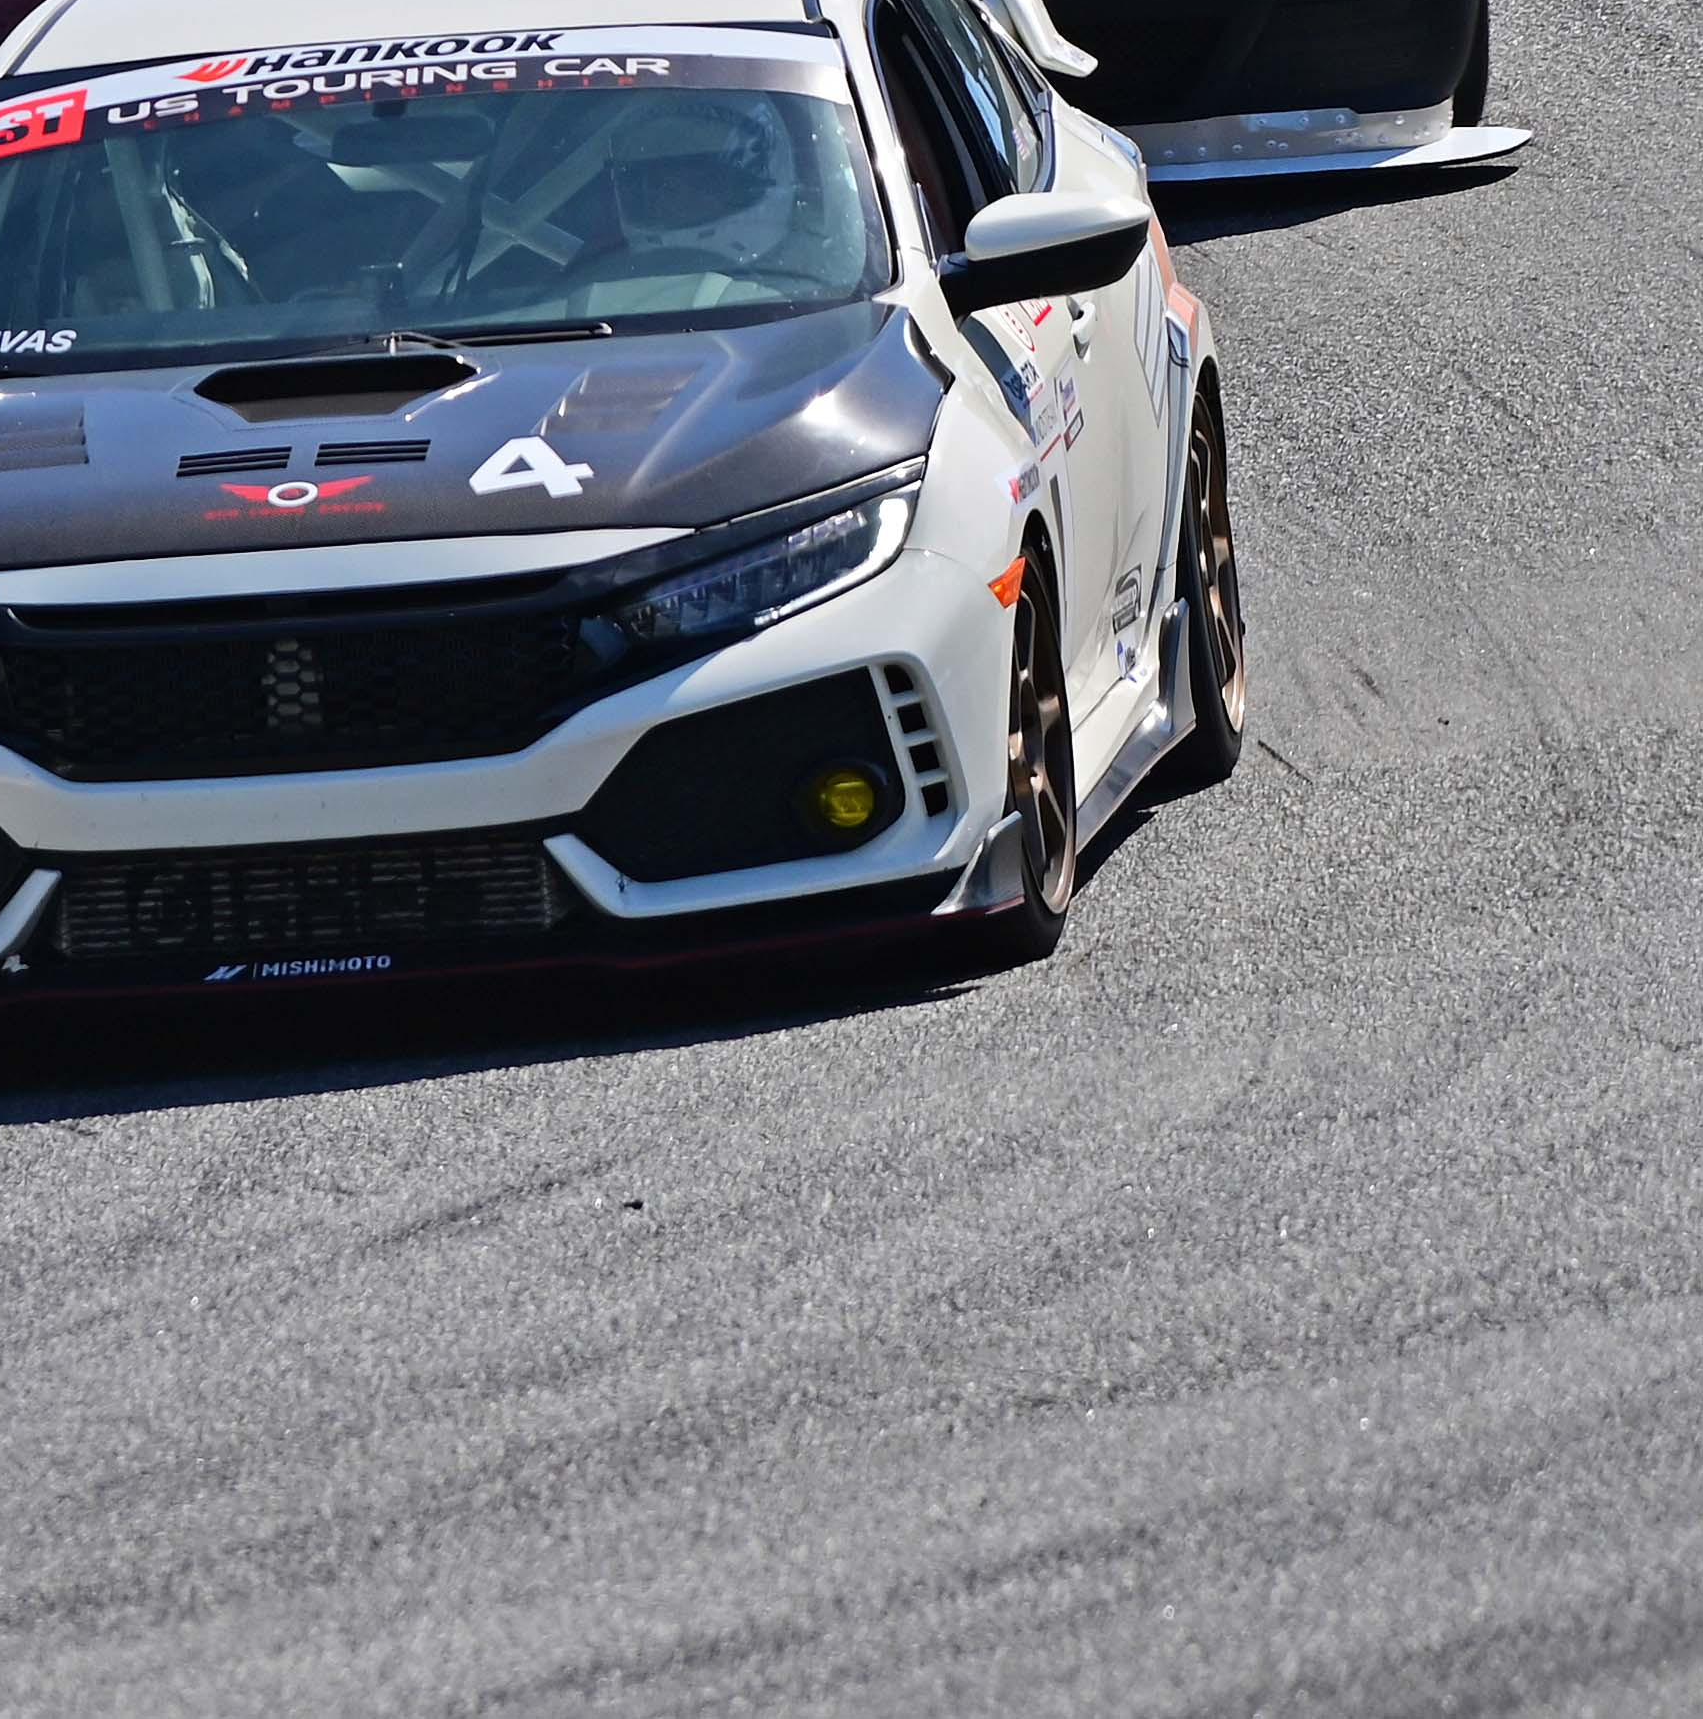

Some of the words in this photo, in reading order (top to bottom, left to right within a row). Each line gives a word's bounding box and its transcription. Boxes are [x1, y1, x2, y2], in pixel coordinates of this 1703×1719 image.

[107, 94, 199, 125] US
[223, 61, 517, 105] TOURING
[544, 58, 671, 77] CAR
[469, 435, 594, 498] 4
[261, 955, 392, 978] MISHIMOTO
